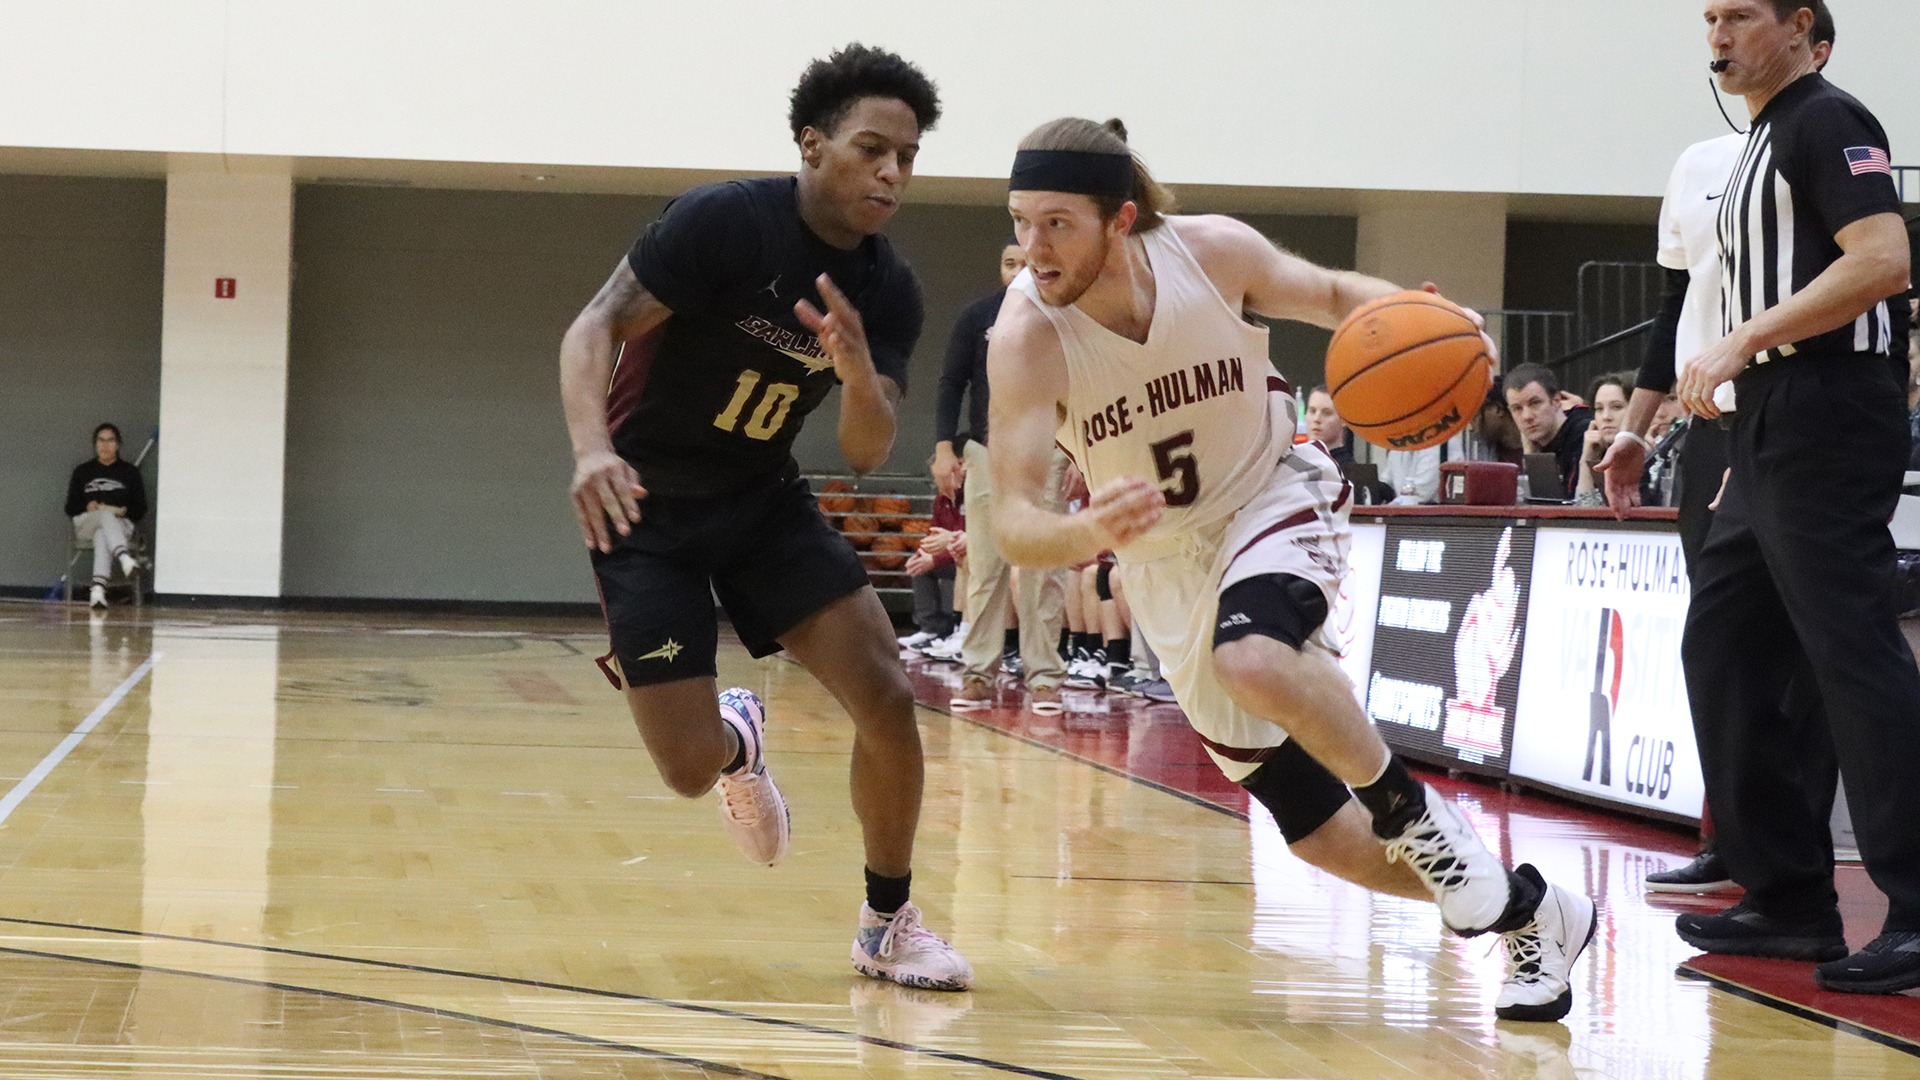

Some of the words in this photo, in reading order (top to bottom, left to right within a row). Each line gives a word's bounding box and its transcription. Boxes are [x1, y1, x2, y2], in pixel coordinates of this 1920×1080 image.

[735, 314, 830, 359] EARLH
[713, 368, 800, 441] 10
[1386, 406, 1462, 448] NCAA
[1149, 428, 1200, 508] 5
[1625, 734, 1675, 800] CLUB
